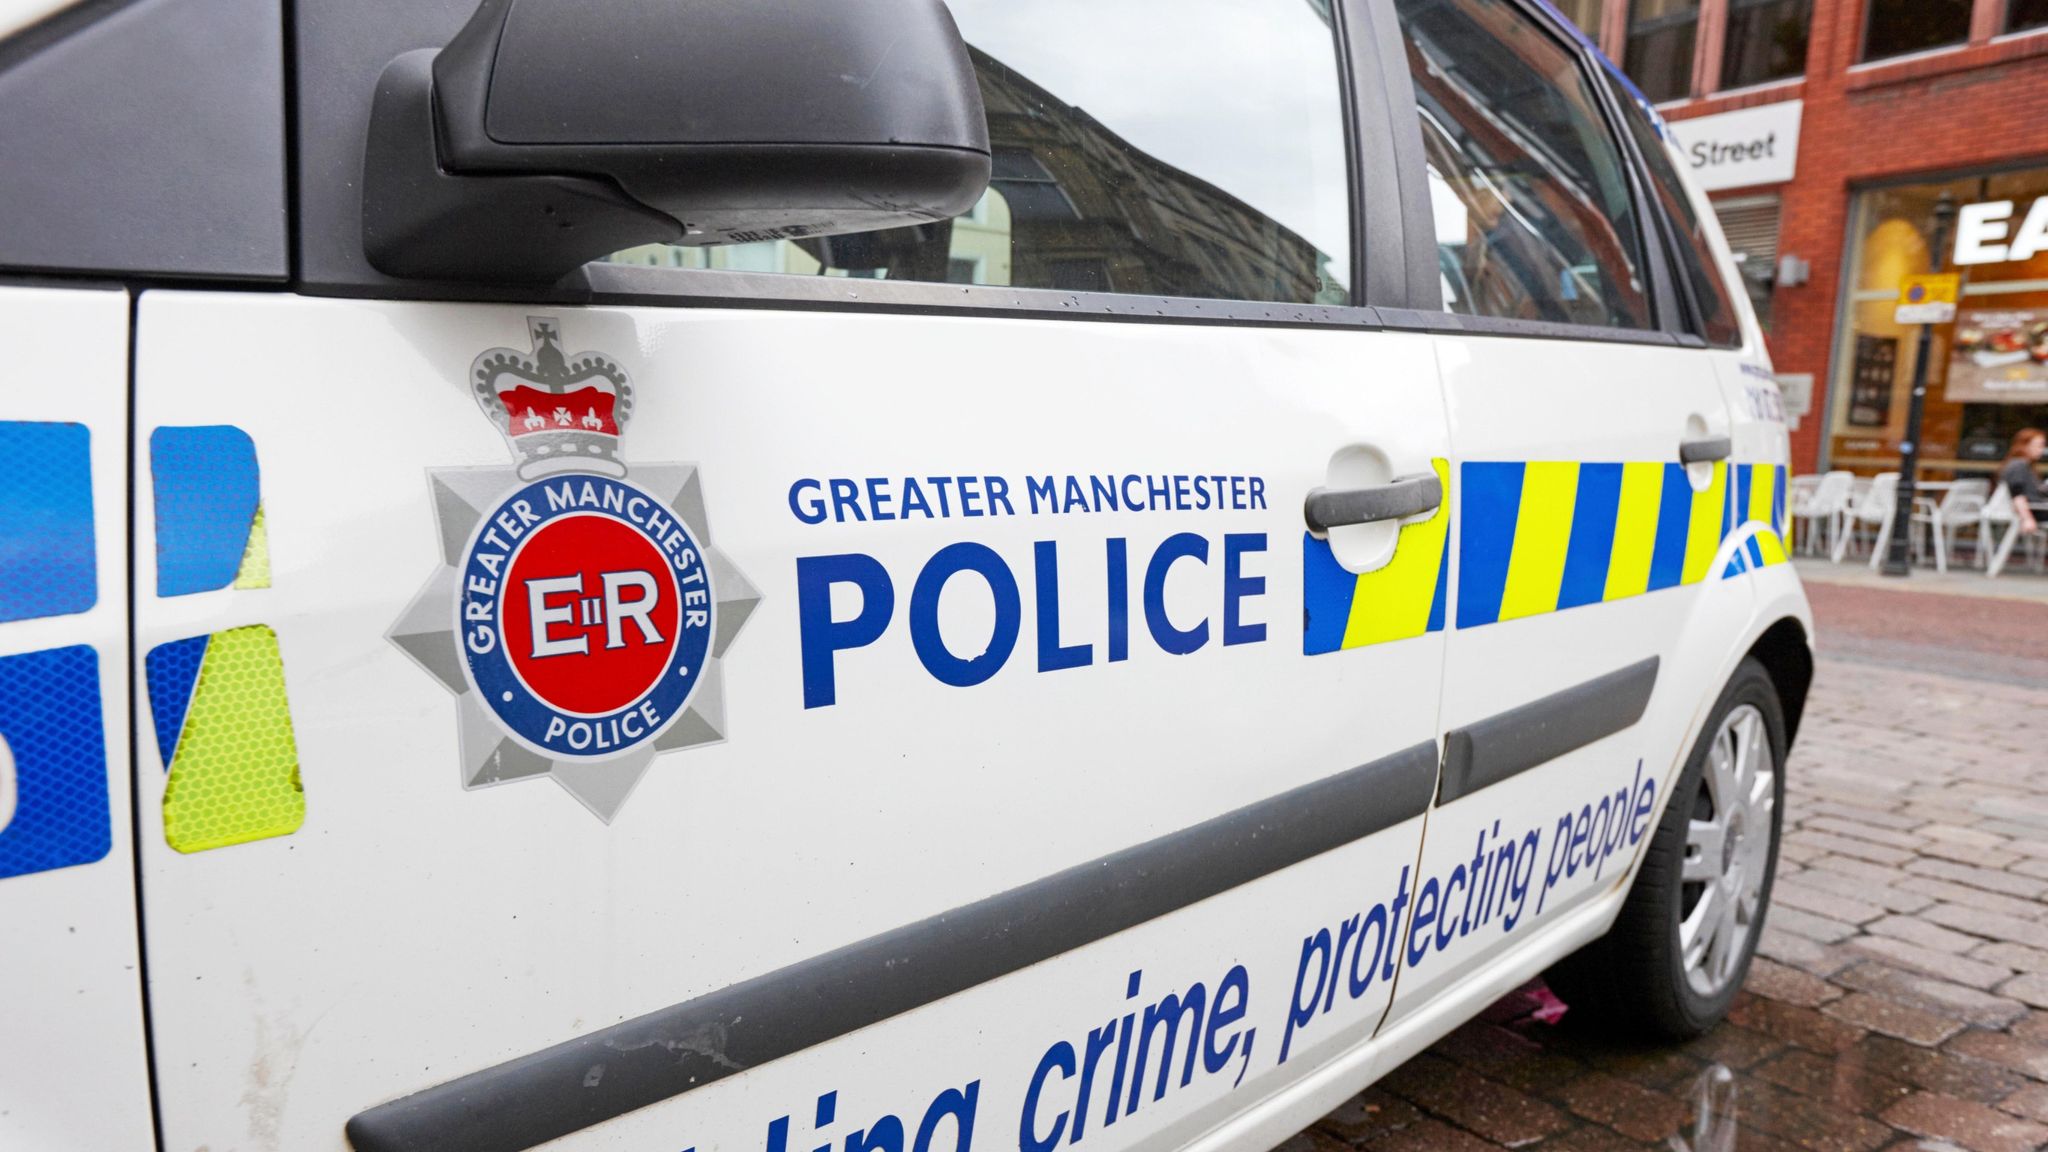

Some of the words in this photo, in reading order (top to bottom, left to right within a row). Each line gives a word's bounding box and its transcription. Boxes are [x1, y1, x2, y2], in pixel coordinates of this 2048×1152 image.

[1690, 131, 1776, 168] Street
[788, 477, 1016, 525] GREATER
[1025, 474, 1268, 515] MANCHESTER
[466, 498, 542, 656] GREATER
[543, 480, 709, 629] MANCHESTER
[796, 531, 1268, 710] POLICE
[543, 700, 662, 750] POLICE
[1019, 964, 1257, 1152] crime,
[1277, 818, 1542, 1066] protecting
[1535, 758, 1657, 916] people
